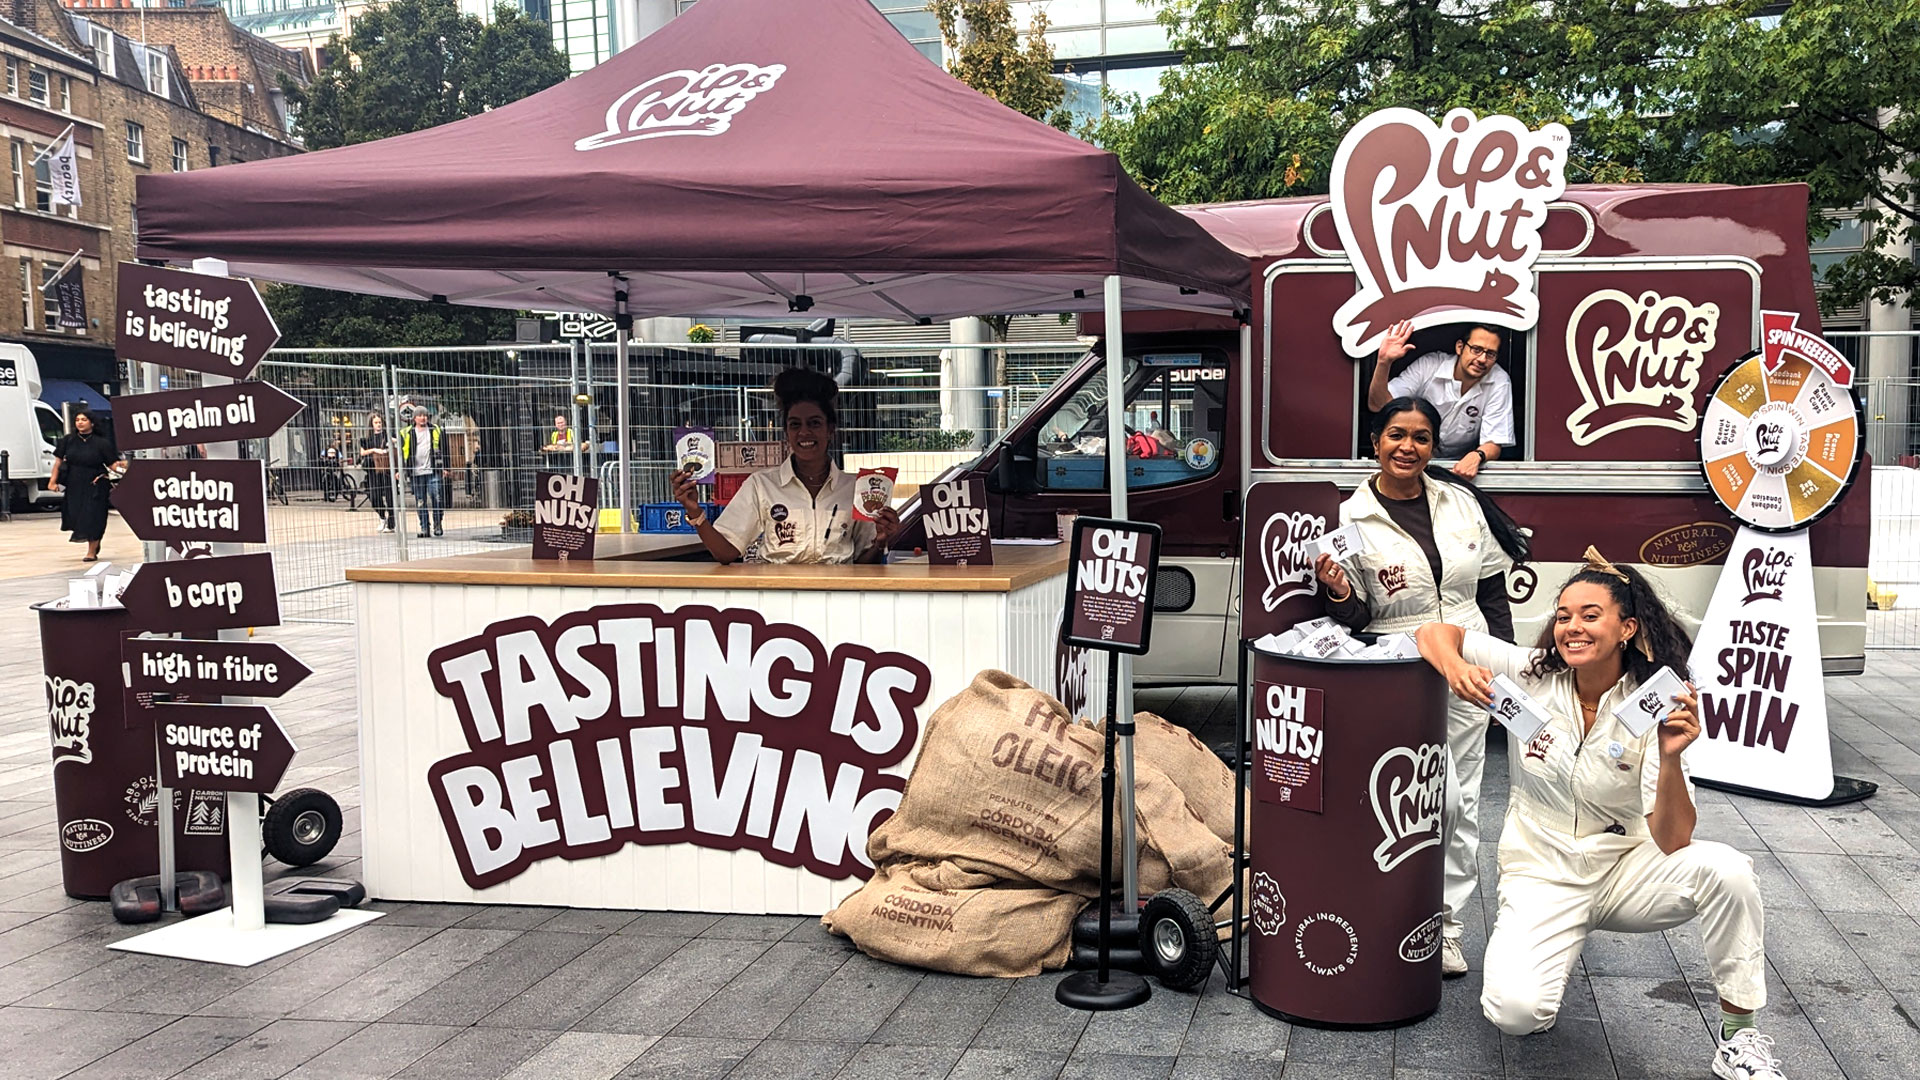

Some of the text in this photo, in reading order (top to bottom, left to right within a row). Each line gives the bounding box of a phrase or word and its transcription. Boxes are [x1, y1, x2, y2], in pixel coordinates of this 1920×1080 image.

[636, 93, 746, 127] Nut
[59, 156, 74, 204] beauty
[1391, 195, 1533, 282] Nut
[144, 284, 231, 329] tasting
[125, 310, 247, 366] is believing
[1767, 329, 1796, 347] SPIN
[1605, 346, 1695, 400] Nut
[1769, 377, 1800, 386] Donation
[1773, 369, 1802, 378] oodbank
[1809, 397, 1822, 414] Cups
[1813, 389, 1829, 411] Butter
[1819, 382, 1836, 408] Peanut
[131, 395, 256, 437] no palm oil
[1715, 418, 1725, 445] Peanut
[1728, 424, 1737, 443] Cups
[1762, 435, 1780, 447] Nut
[1829, 433, 1840, 461] Peanut
[1767, 463, 1791, 475] SPIN
[153, 471, 234, 501] carbon
[548, 474, 585, 502] OH
[932, 480, 971, 508] OH
[1752, 493, 1782, 503] Donation
[152, 503, 239, 531] neutral
[535, 499, 597, 533] NUTS!
[1751, 501, 1782, 512] Foodbank
[922, 508, 989, 539] NUTS!
[1092, 528, 1139, 562] OH
[1651, 539, 1726, 564] NUTTINESS
[1653, 528, 1718, 550] NATURAL
[1677, 541, 1698, 552] P&N
[1278, 546, 1314, 581] Nu
[1075, 559, 1148, 603] NUTS!
[1386, 575, 1406, 589] Nut
[1753, 569, 1787, 590] Nut
[164, 577, 243, 614] b corp
[1729, 620, 1790, 650] TASTE
[142, 651, 191, 684] high
[197, 655, 217, 680] in
[223, 656, 279, 684] fibre
[1717, 648, 1792, 693] SPIN
[441, 618, 917, 754] TASTING IS
[1267, 685, 1306, 722] OH
[166, 723, 262, 751] source of
[1702, 691, 1800, 753] WIN
[1256, 718, 1323, 765] NUTS!
[176, 749, 253, 779] protein
[992, 731, 1094, 796] OLEIC
[124, 775, 182, 810] ABSOLELY
[126, 809, 150, 826] SINCE
[989, 793, 1059, 826] PEANUTS FROM
[1400, 783, 1441, 833] Nut
[65, 833, 107, 849] NUTTINESS
[66, 823, 101, 837] NATURAL
[1256, 880, 1279, 902] AWARD
[1254, 899, 1280, 930] WINNING
[1295, 912, 1359, 965] NATURAL INGREDIENTS
[1305, 961, 1345, 976] ALWAYS
